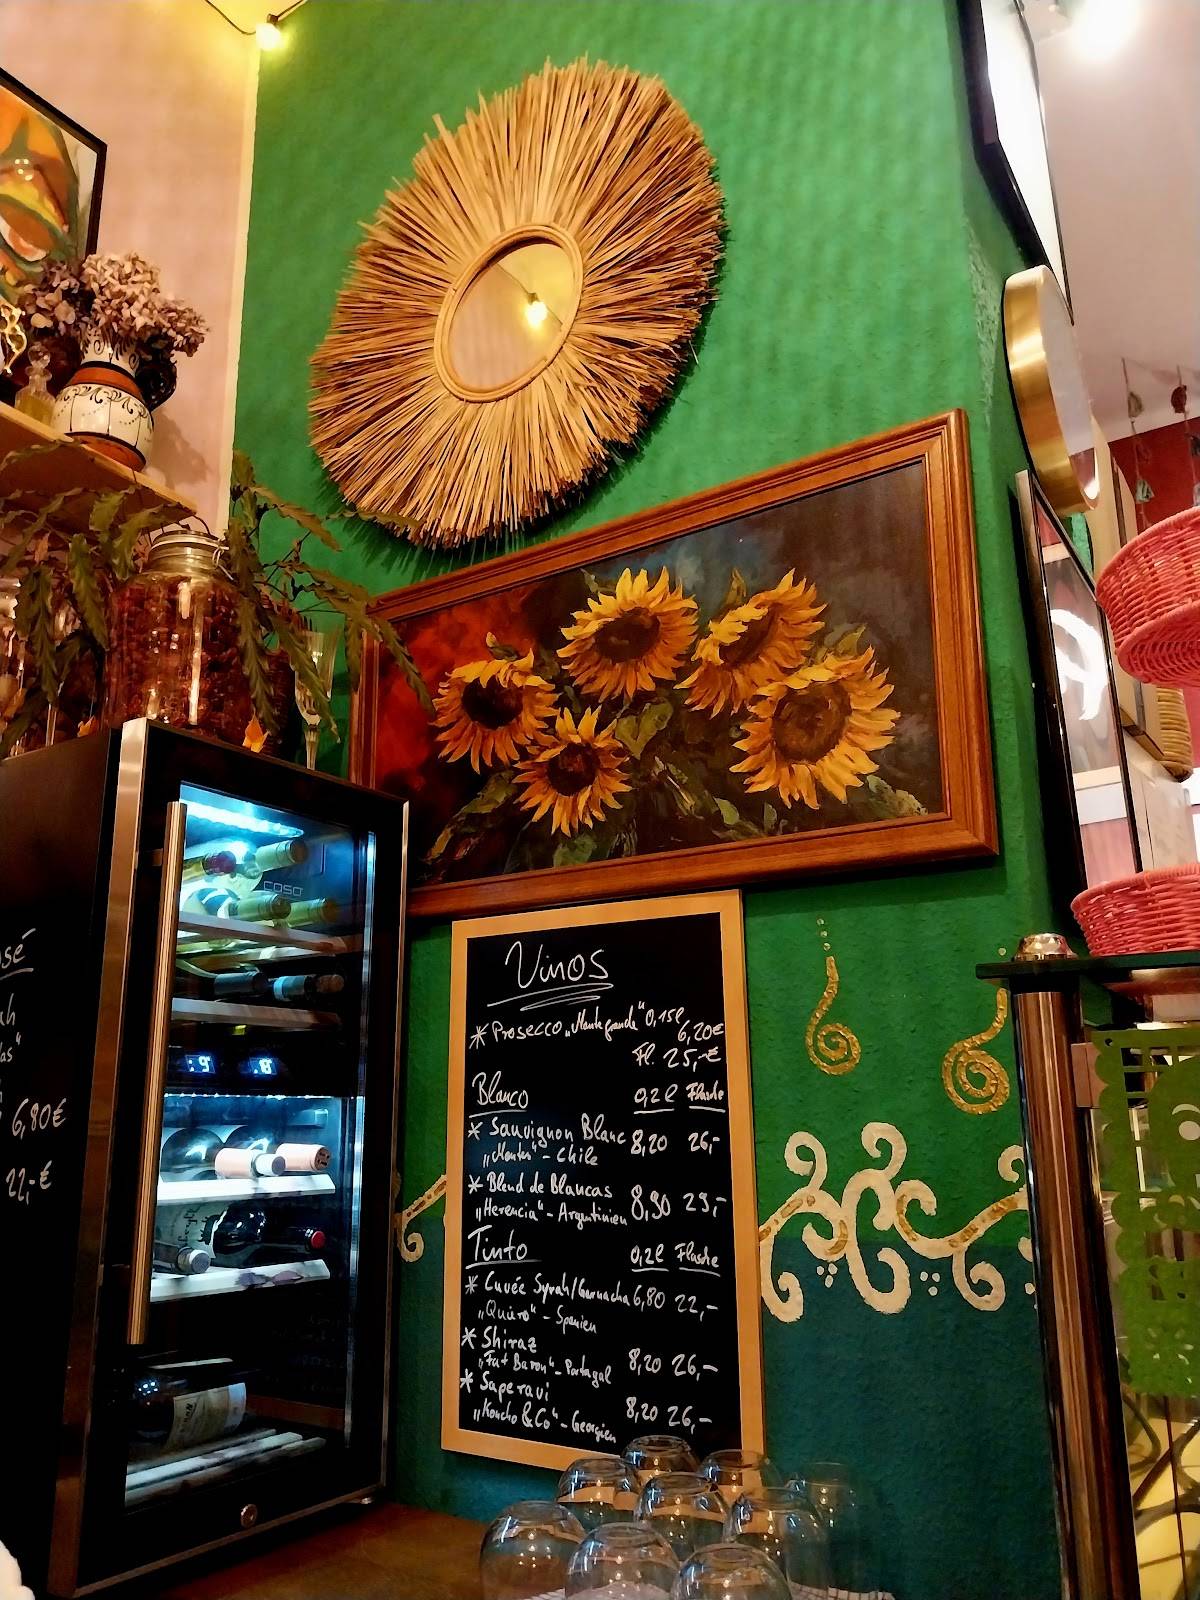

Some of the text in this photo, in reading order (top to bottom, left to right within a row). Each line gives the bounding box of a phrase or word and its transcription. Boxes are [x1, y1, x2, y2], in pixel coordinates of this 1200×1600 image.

[504, 940, 609, 989] Vinos
[491, 1020, 563, 1041] Prosecco
[677, 1020, 725, 1046] 6,20€
[471, 1071, 529, 1109] Blanco
[12, 1098, 66, 1140] 6,80€
[489, 1117, 574, 1149] Sauvignon
[581, 1113, 627, 1145] Blanc
[630, 1130, 668, 1157] 8,20
[556, 1143, 599, 1166] Chile
[486, 1173, 524, 1195] Blend
[529, 1174, 544, 1195] de
[550, 1173, 613, 1199] Blancas
[467, 1225, 528, 1262] Tinto
[484, 1270, 527, 1296] Cuvée
[632, 1284, 666, 1312] 6,80
[555, 1304, 598, 1335] Spanien
[481, 1326, 537, 1353] Shiraz
[628, 1347, 662, 1376] 8,20
[626, 1396, 659, 1424] 8,20
